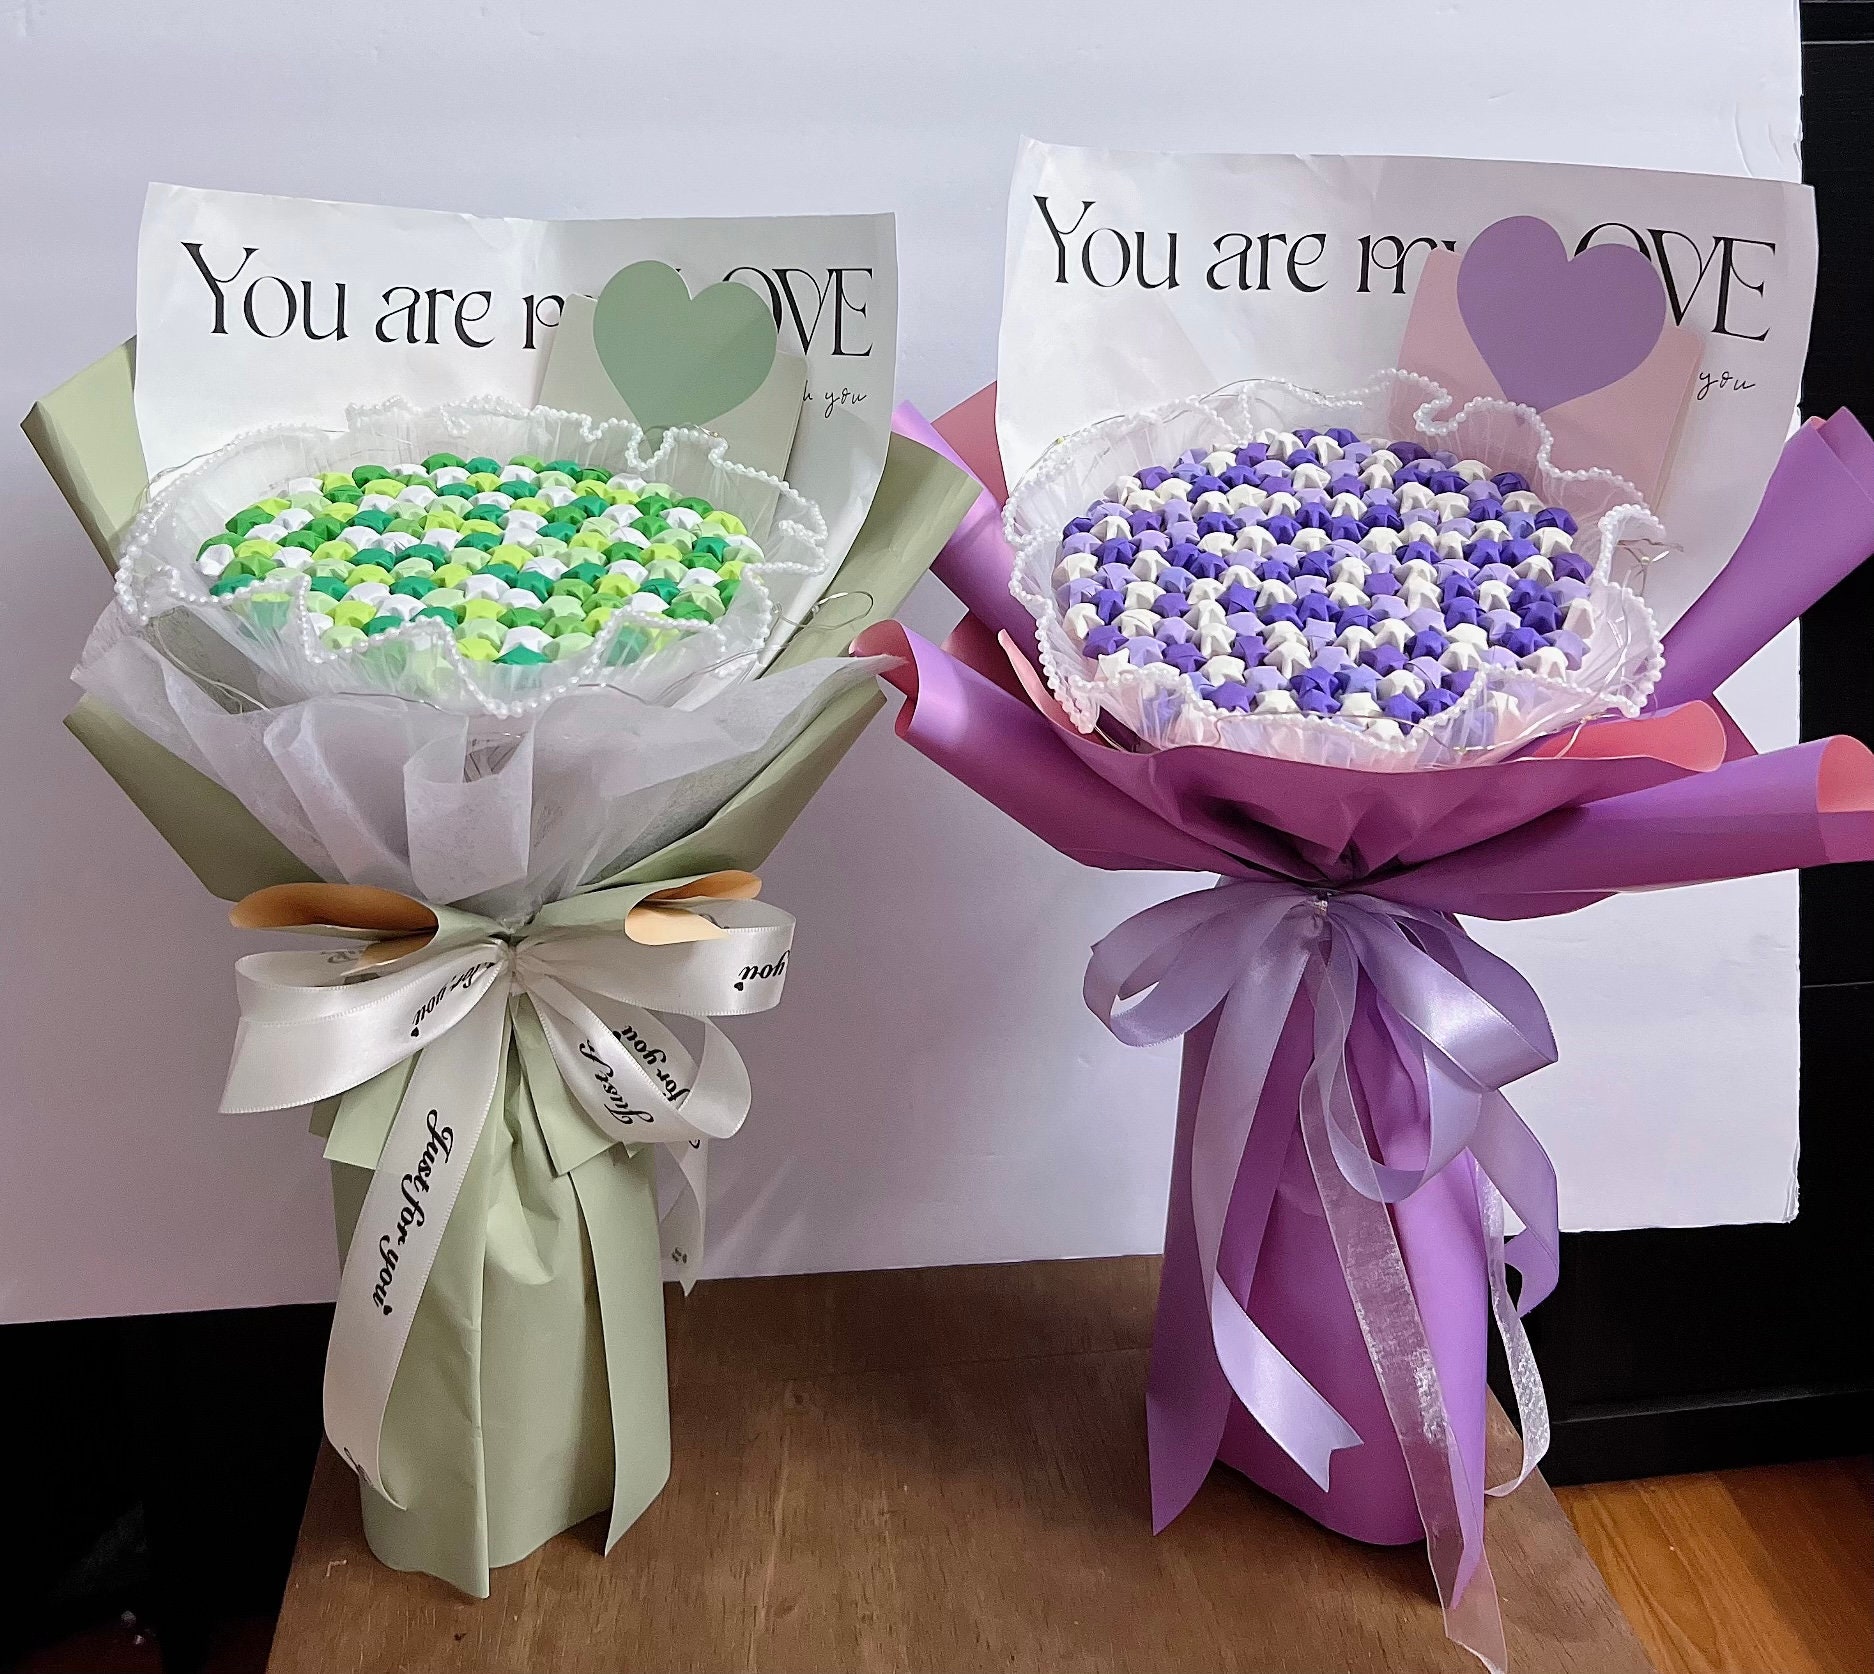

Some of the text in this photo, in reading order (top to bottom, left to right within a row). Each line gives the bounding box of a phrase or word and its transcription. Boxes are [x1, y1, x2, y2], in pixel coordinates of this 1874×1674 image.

[1033, 194, 1180, 290] You
[1206, 233, 1329, 293] are
[181, 241, 349, 341] You
[375, 286, 496, 348] are
[825, 387, 867, 418] you
[1697, 371, 1756, 401] you
[621, 1025, 667, 1065] you
[372, 1109, 454, 1309] Just for you
